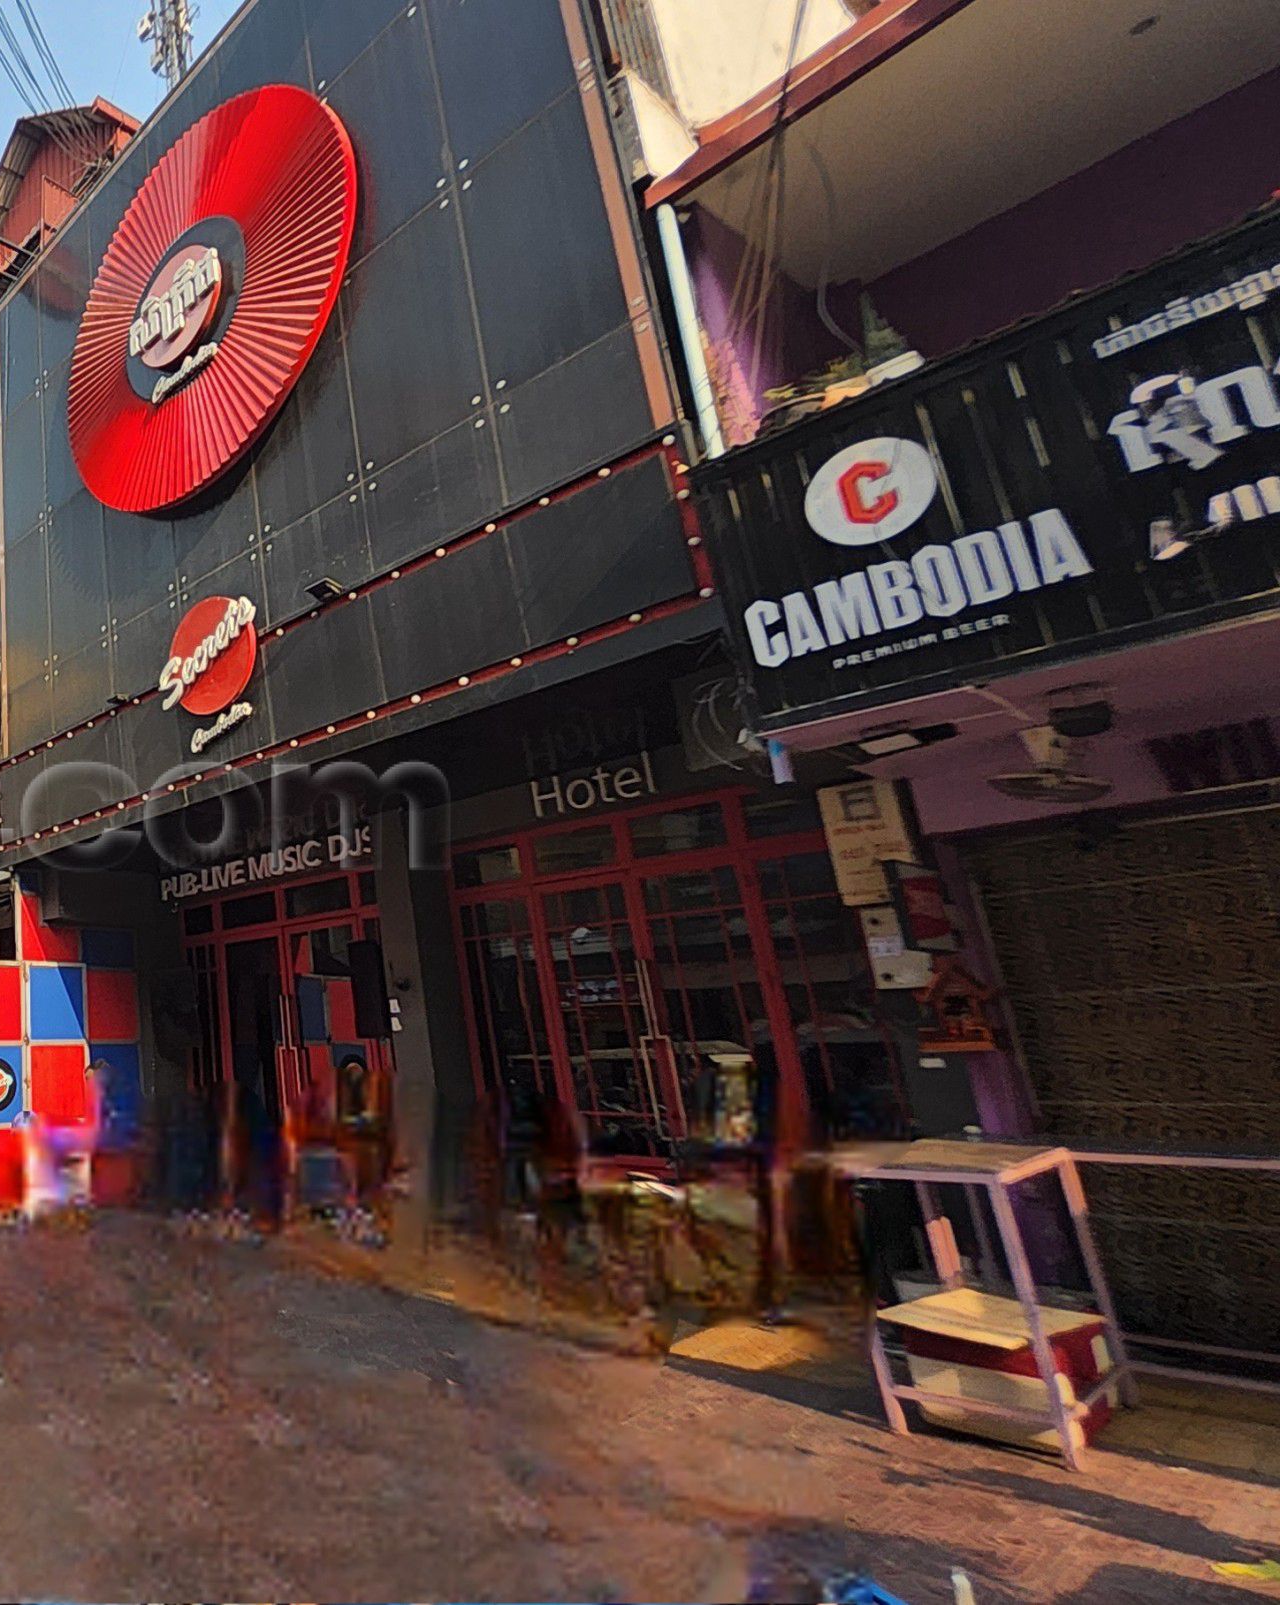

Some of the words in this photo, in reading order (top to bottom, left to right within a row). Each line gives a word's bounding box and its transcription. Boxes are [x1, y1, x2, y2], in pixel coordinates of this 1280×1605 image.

[744, 507, 1095, 669] CAMBODIA
[158, 595, 257, 712] Secrets
[832, 633, 937, 670] PREMIUM
[942, 613, 1011, 640] BEER
[530, 749, 656, 819] Hotel
[160, 859, 248, 901] PUB-LIVE
[248, 839, 322, 882] MUSIC
